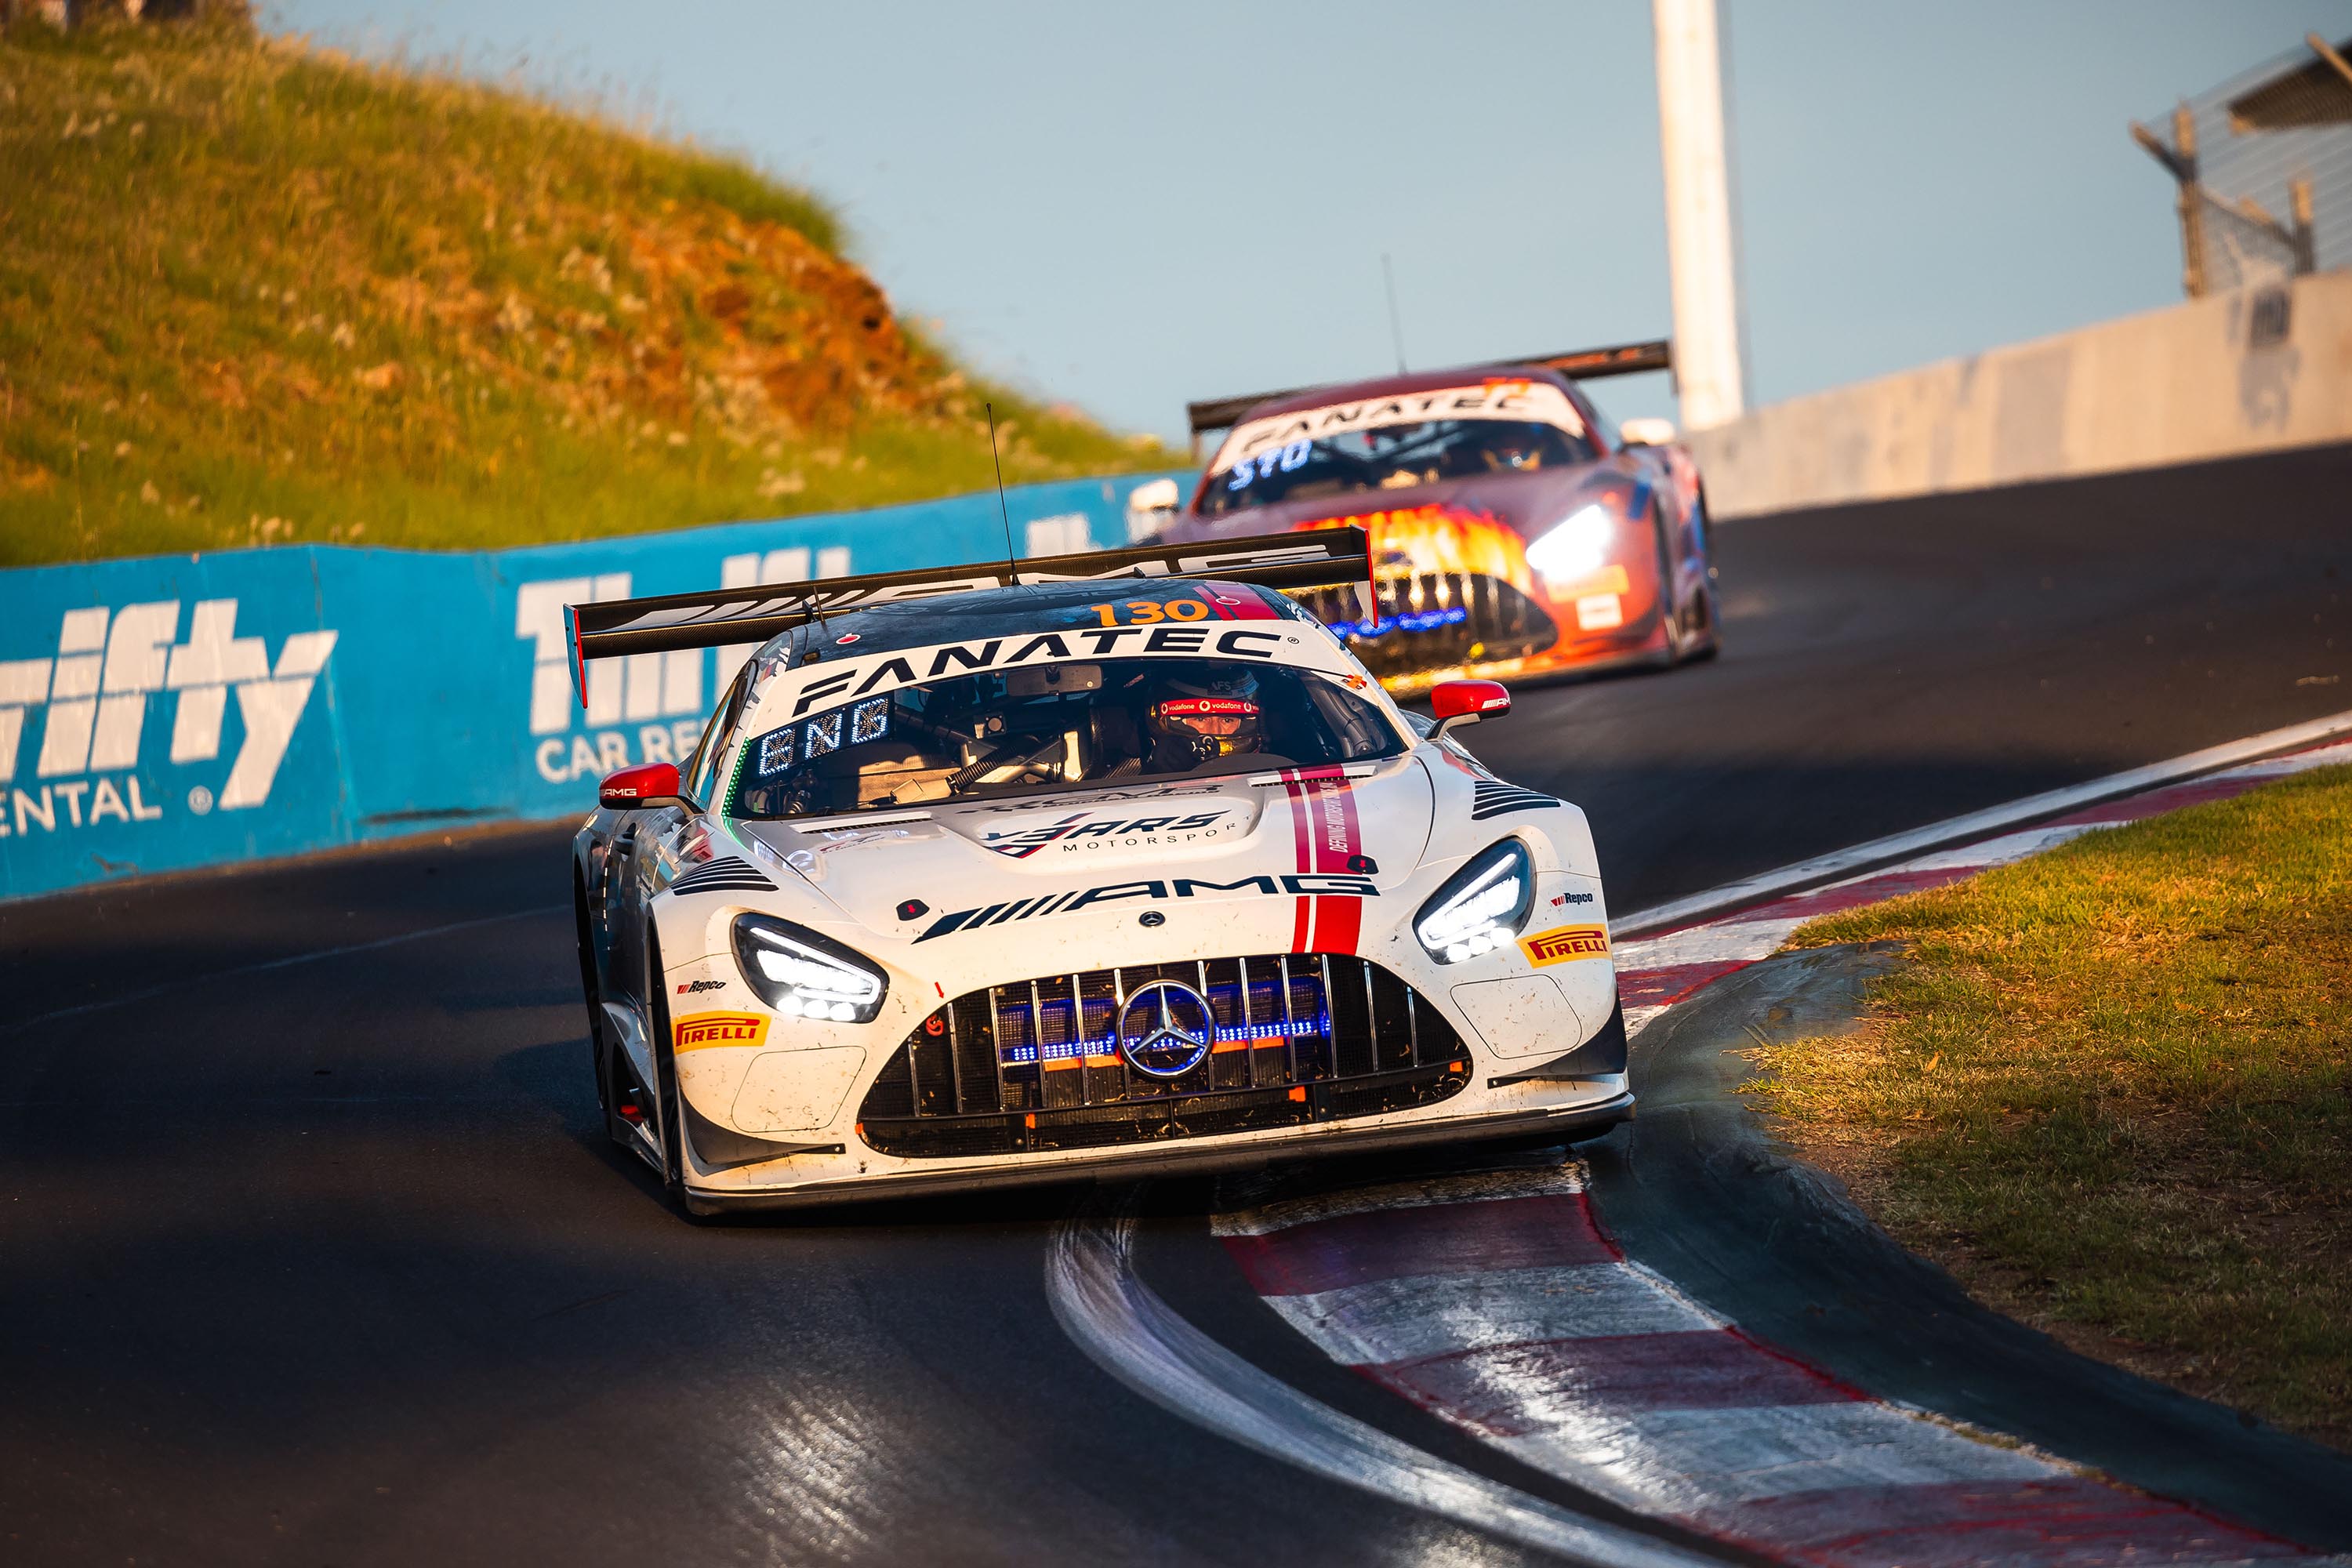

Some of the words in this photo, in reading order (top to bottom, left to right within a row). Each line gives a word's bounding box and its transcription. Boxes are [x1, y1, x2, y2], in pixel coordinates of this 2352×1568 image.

[1091, 599, 1210, 627] 130
[792, 628, 1282, 717] FANATEC
[535, 729, 628, 783] CAR
[603, 788, 637, 797] AMG
[1063, 814, 1251, 852] MOTORSPORT
[1061, 873, 1381, 912] AMG
[1563, 892, 1593, 906] Repco
[1527, 930, 1608, 960] PIRELLI
[688, 980, 727, 994] Repco
[675, 1017, 760, 1047] PIRELLI
